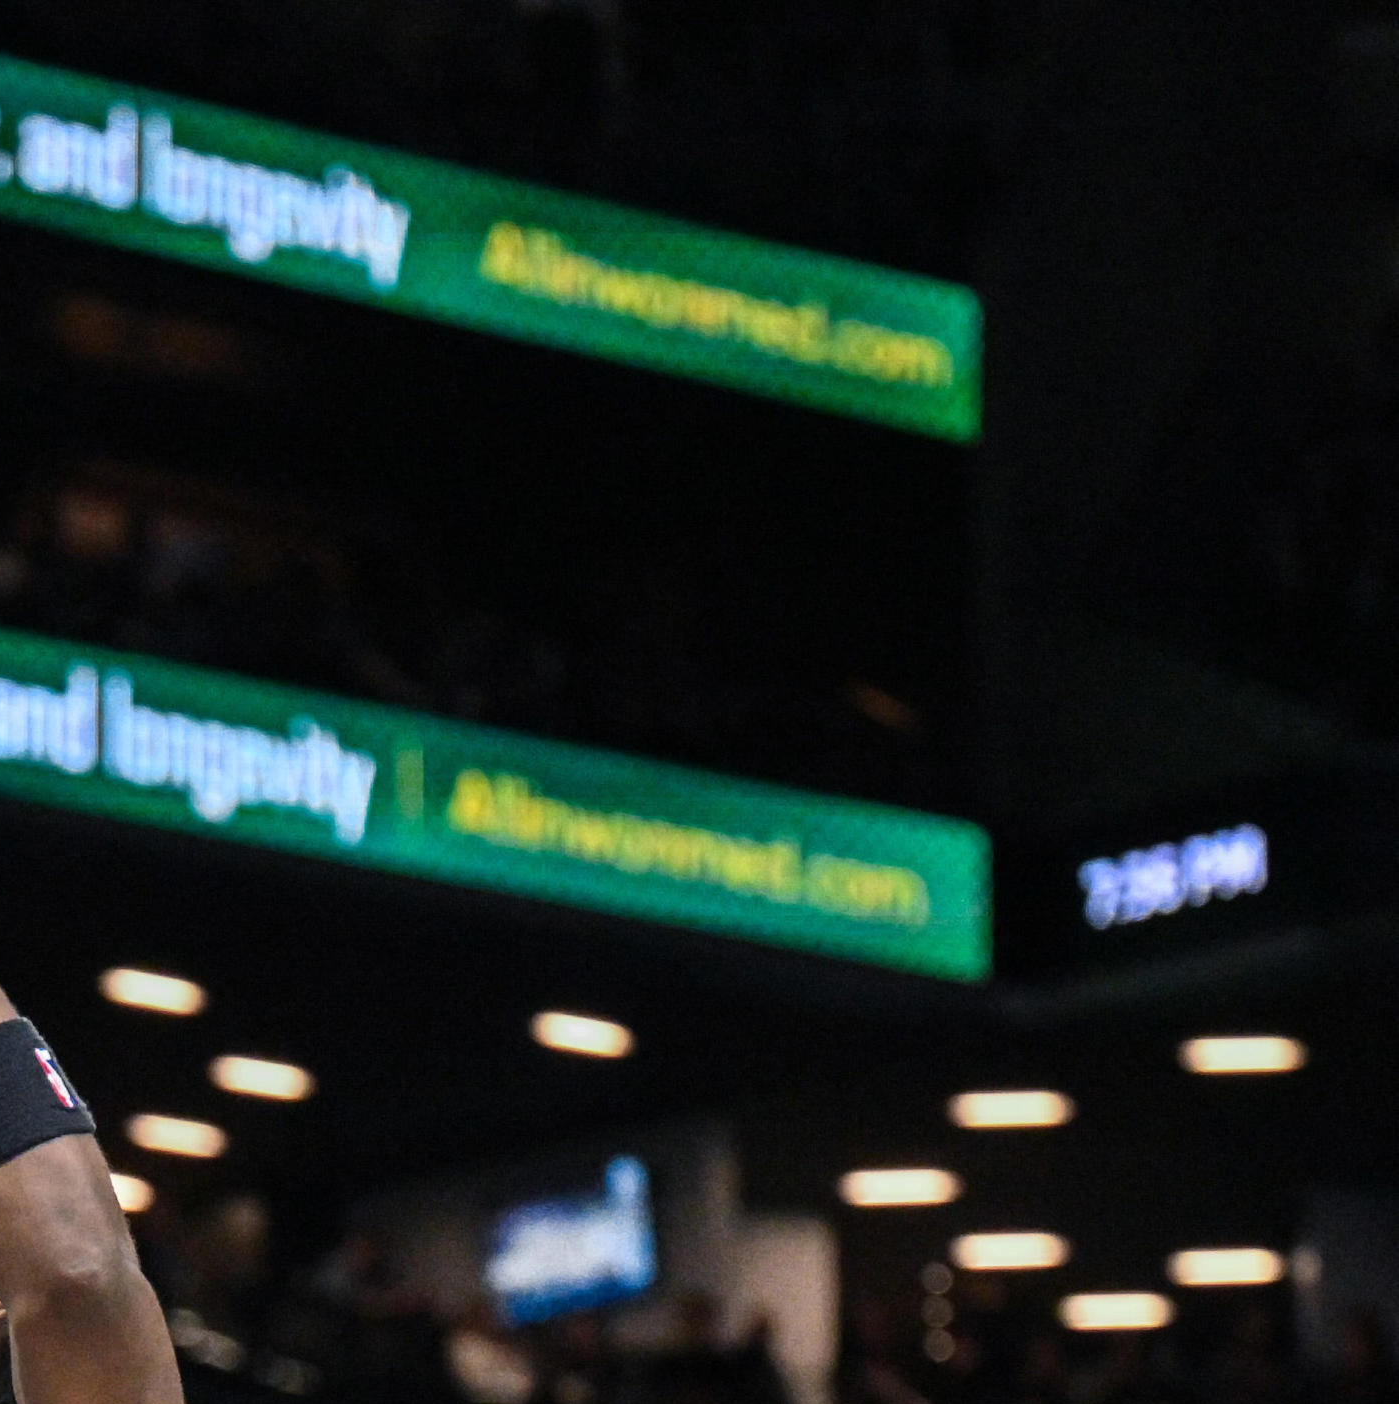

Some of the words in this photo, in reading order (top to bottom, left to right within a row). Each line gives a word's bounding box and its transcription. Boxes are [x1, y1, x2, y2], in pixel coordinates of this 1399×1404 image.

[16, 112, 140, 212] and
[140, 108, 409, 294] longevity
[101, 669, 378, 845] longevity
